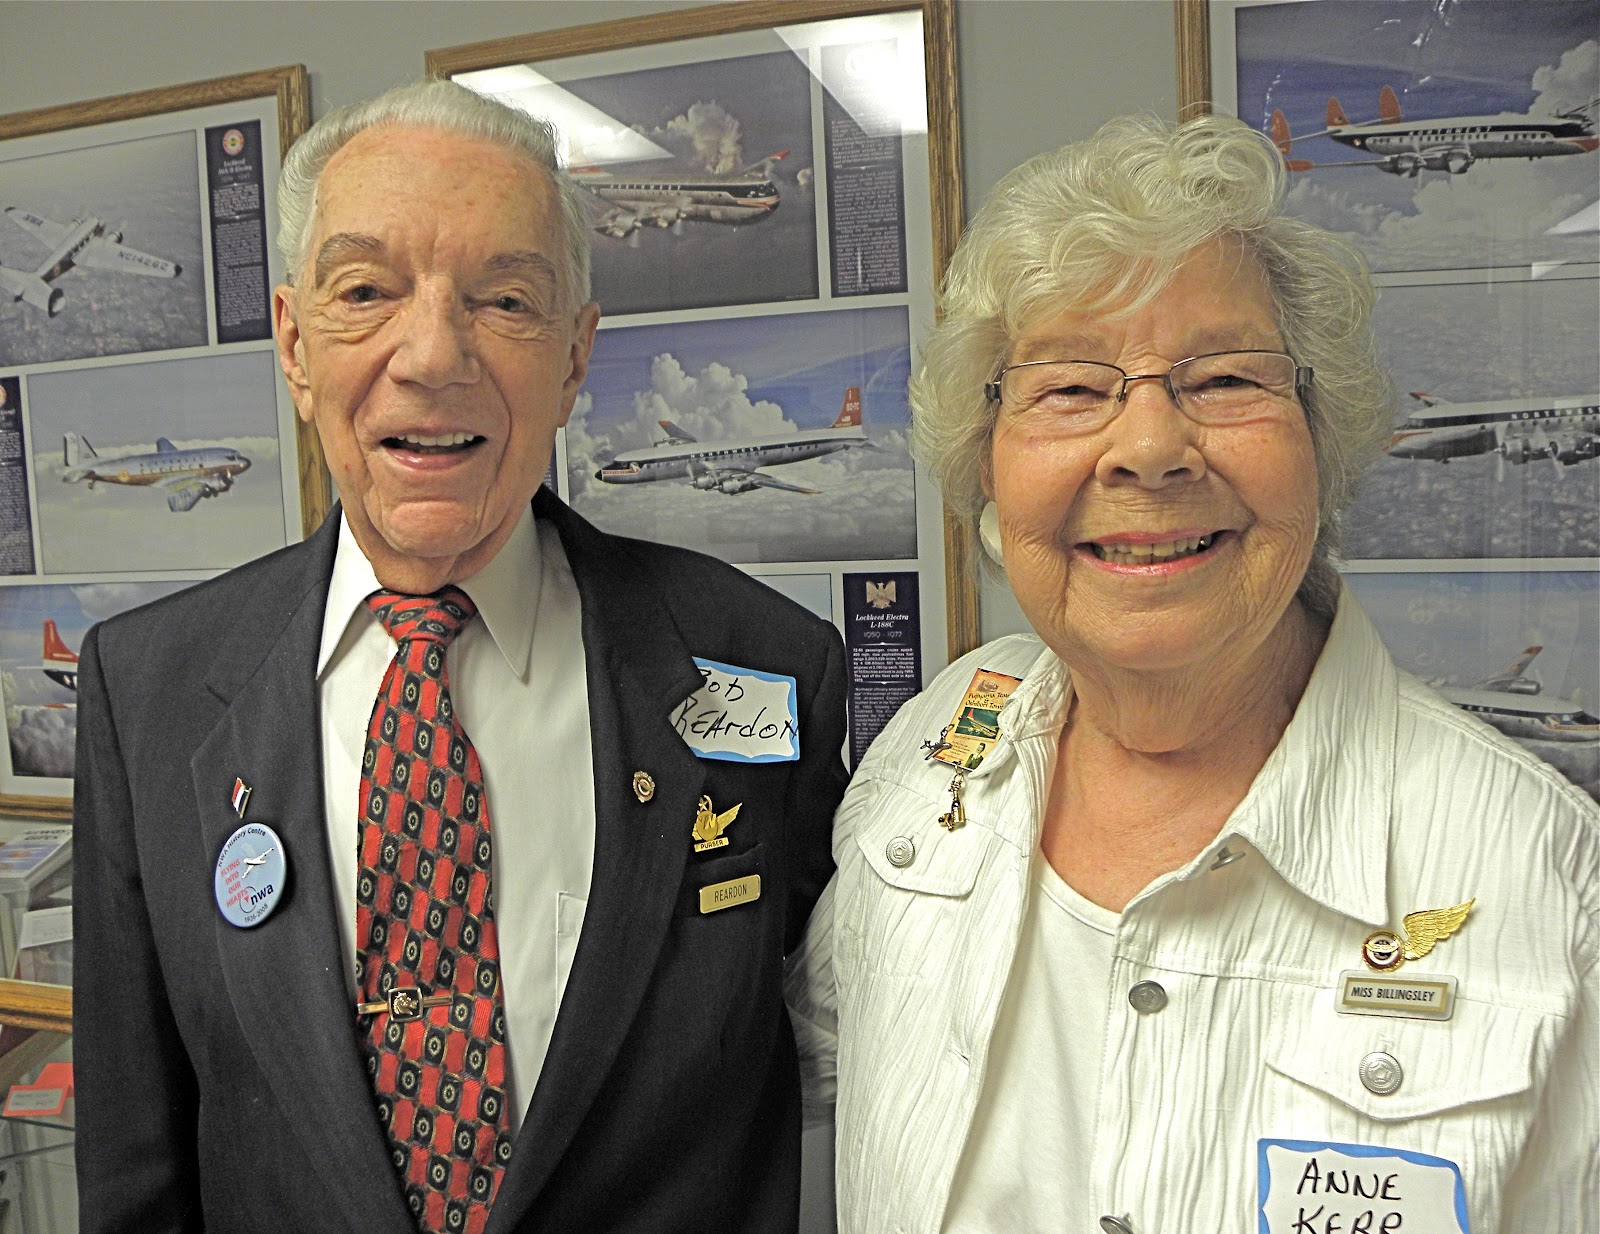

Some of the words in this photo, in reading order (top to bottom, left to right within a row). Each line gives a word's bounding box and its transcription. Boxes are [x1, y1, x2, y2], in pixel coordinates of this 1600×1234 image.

[1511, 406, 1600, 420] NORTHWES
[855, 613, 885, 621] Lockheed
[886, 613, 909, 621] Electra
[870, 621, 895, 629] L-188C
[218, 849, 228, 867] NWA
[227, 829, 247, 849] History
[247, 827, 267, 837] Centre
[700, 839, 724, 850] PURSER
[220, 859, 241, 877] FLYING
[225, 871, 240, 885] INTO
[228, 881, 241, 894] OUR
[250, 883, 274, 906] nwa
[714, 883, 748, 903] REARDON
[226, 888, 249, 908] HEARTS
[1350, 986, 1373, 998] MISS
[1376, 988, 1435, 1002] BILLINGSLEY
[1296, 1157, 1402, 1201] ANNE
